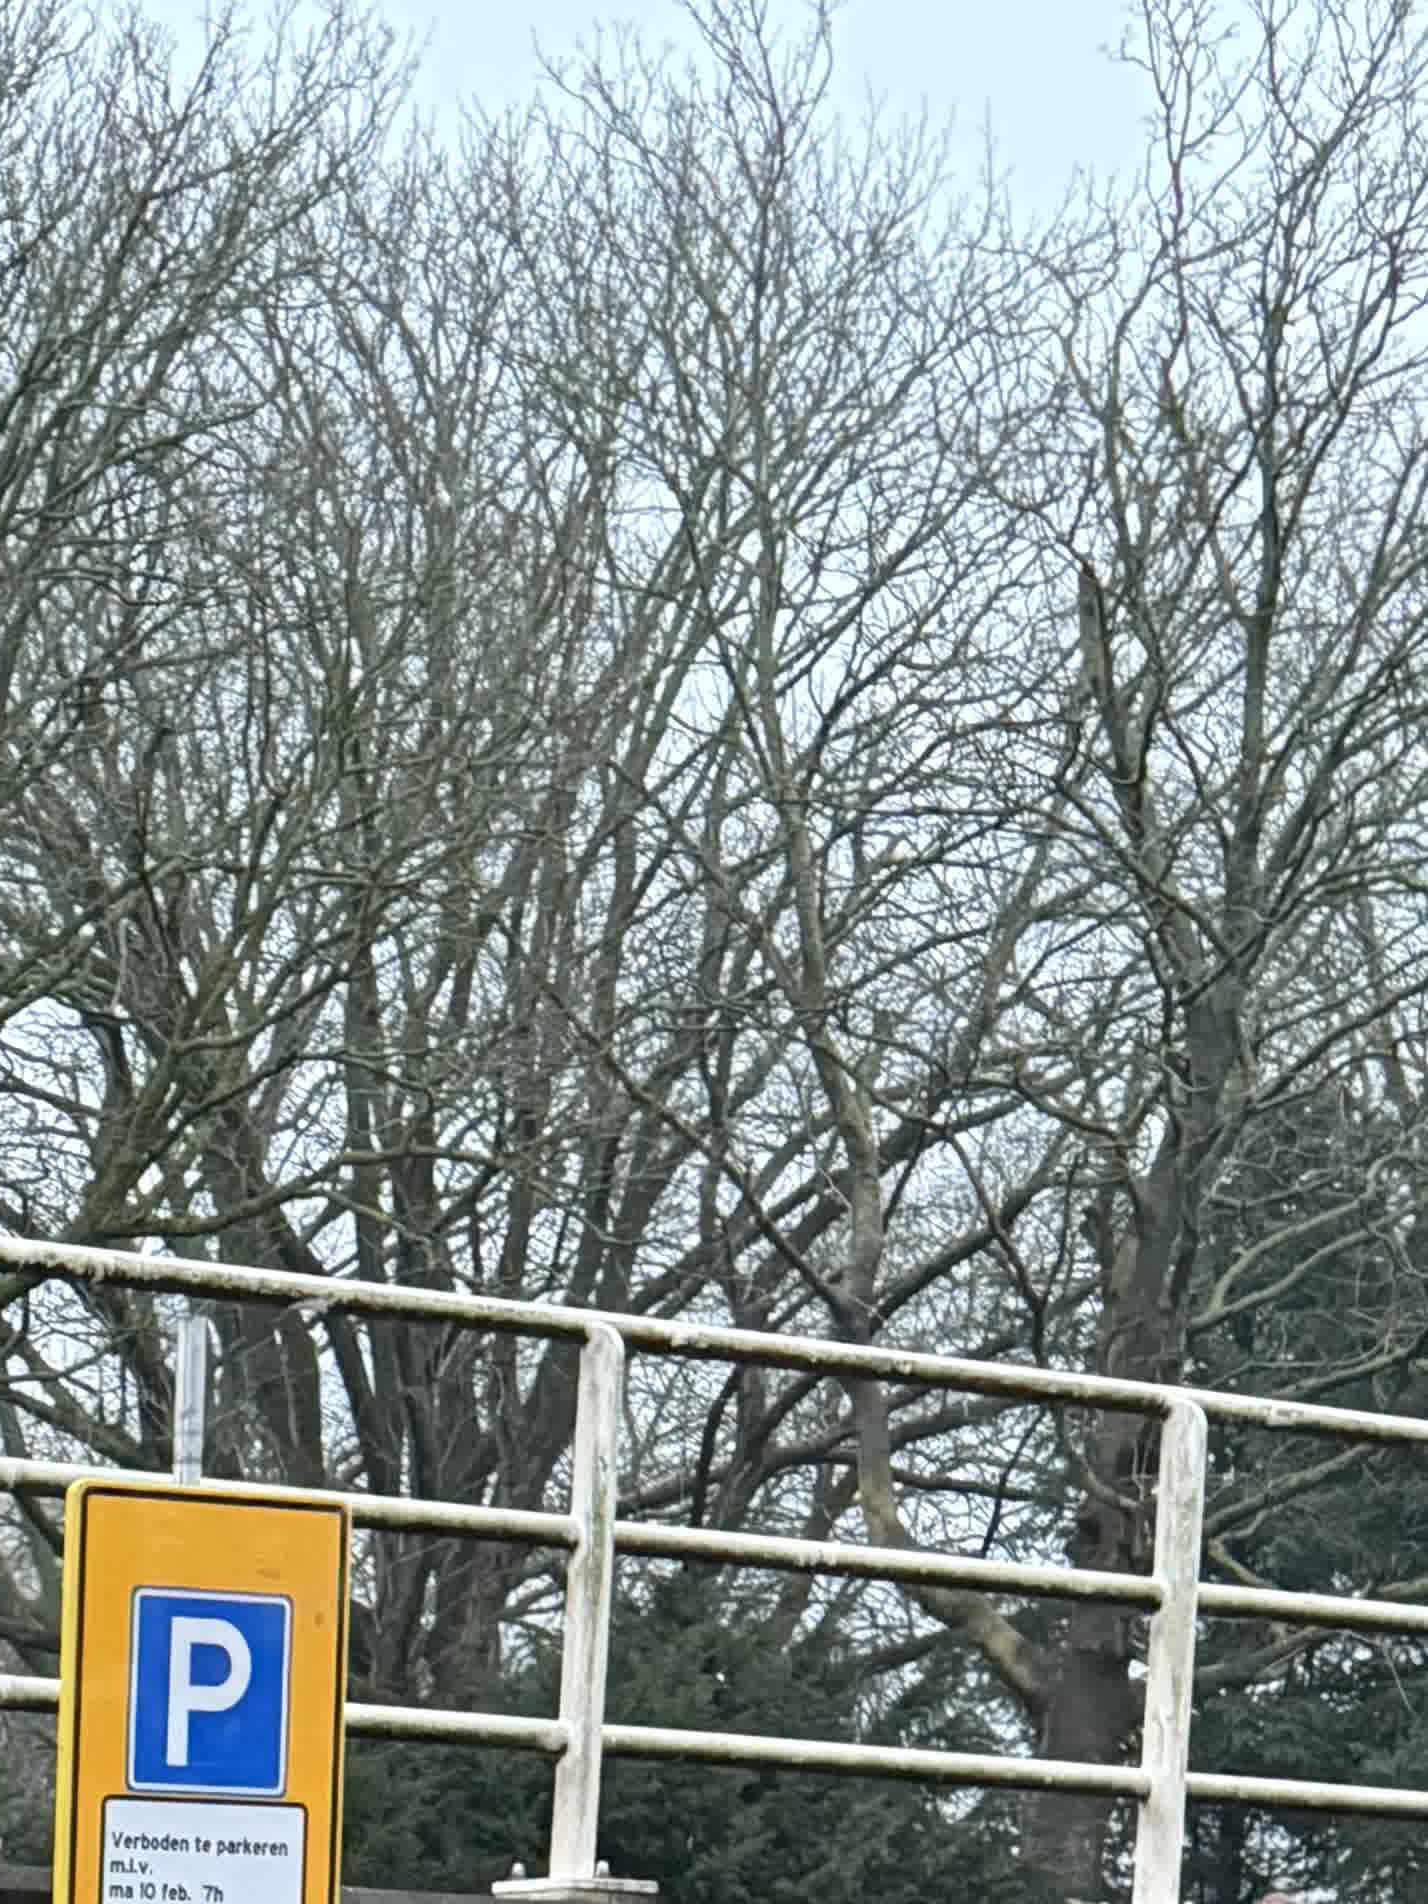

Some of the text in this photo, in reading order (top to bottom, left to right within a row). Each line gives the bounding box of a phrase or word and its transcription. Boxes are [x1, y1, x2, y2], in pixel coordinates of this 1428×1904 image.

[165, 1616, 252, 1767] P
[111, 1831, 289, 1857] Verboden te parkeren
[109, 1882, 224, 1903] ma 10 feb. 7h
